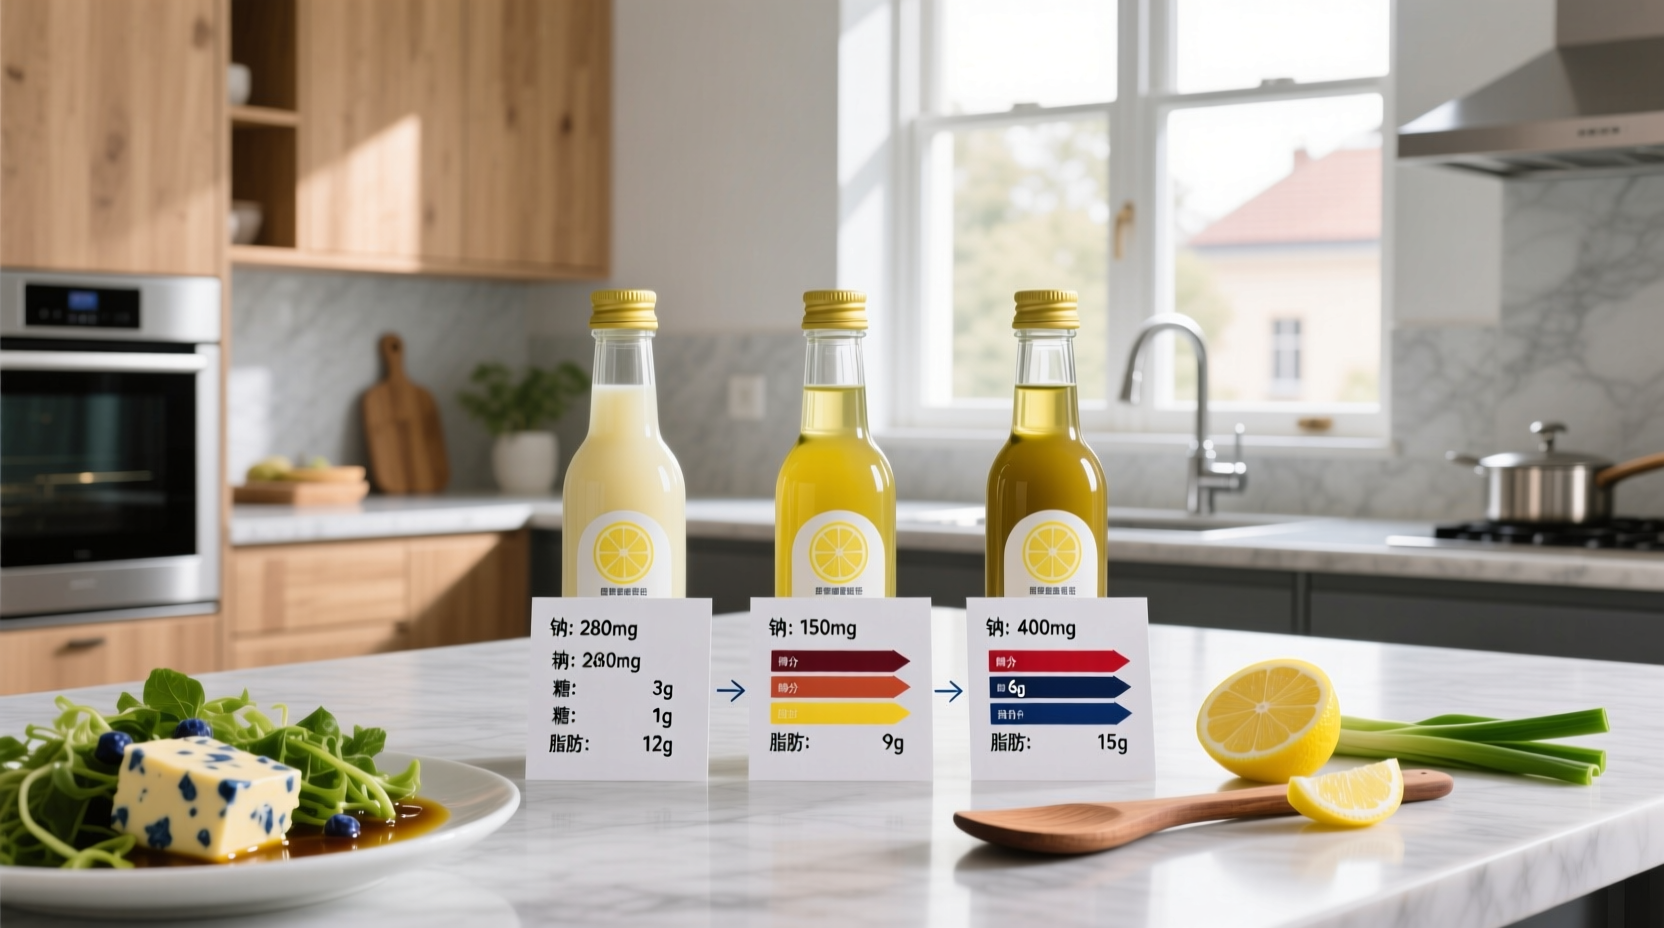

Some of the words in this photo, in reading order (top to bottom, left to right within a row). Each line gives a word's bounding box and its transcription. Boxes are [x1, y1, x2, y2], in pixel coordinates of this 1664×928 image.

[580, 619, 638, 641] 280mg
[769, 617, 793, 638] 钠:
[801, 619, 857, 640] 150mg
[986, 617, 1010, 638] 钠:
[1017, 619, 1076, 640] 400mg
[652, 680, 673, 700] 3g
[652, 708, 672, 729] 1g
[549, 734, 590, 753] 脂肪:
[643, 735, 673, 757] 12g
[770, 732, 810, 752] 脂肪:
[882, 733, 904, 755] 9g
[991, 732, 1031, 752] 脂肪:
[1098, 733, 1128, 755] 15g
